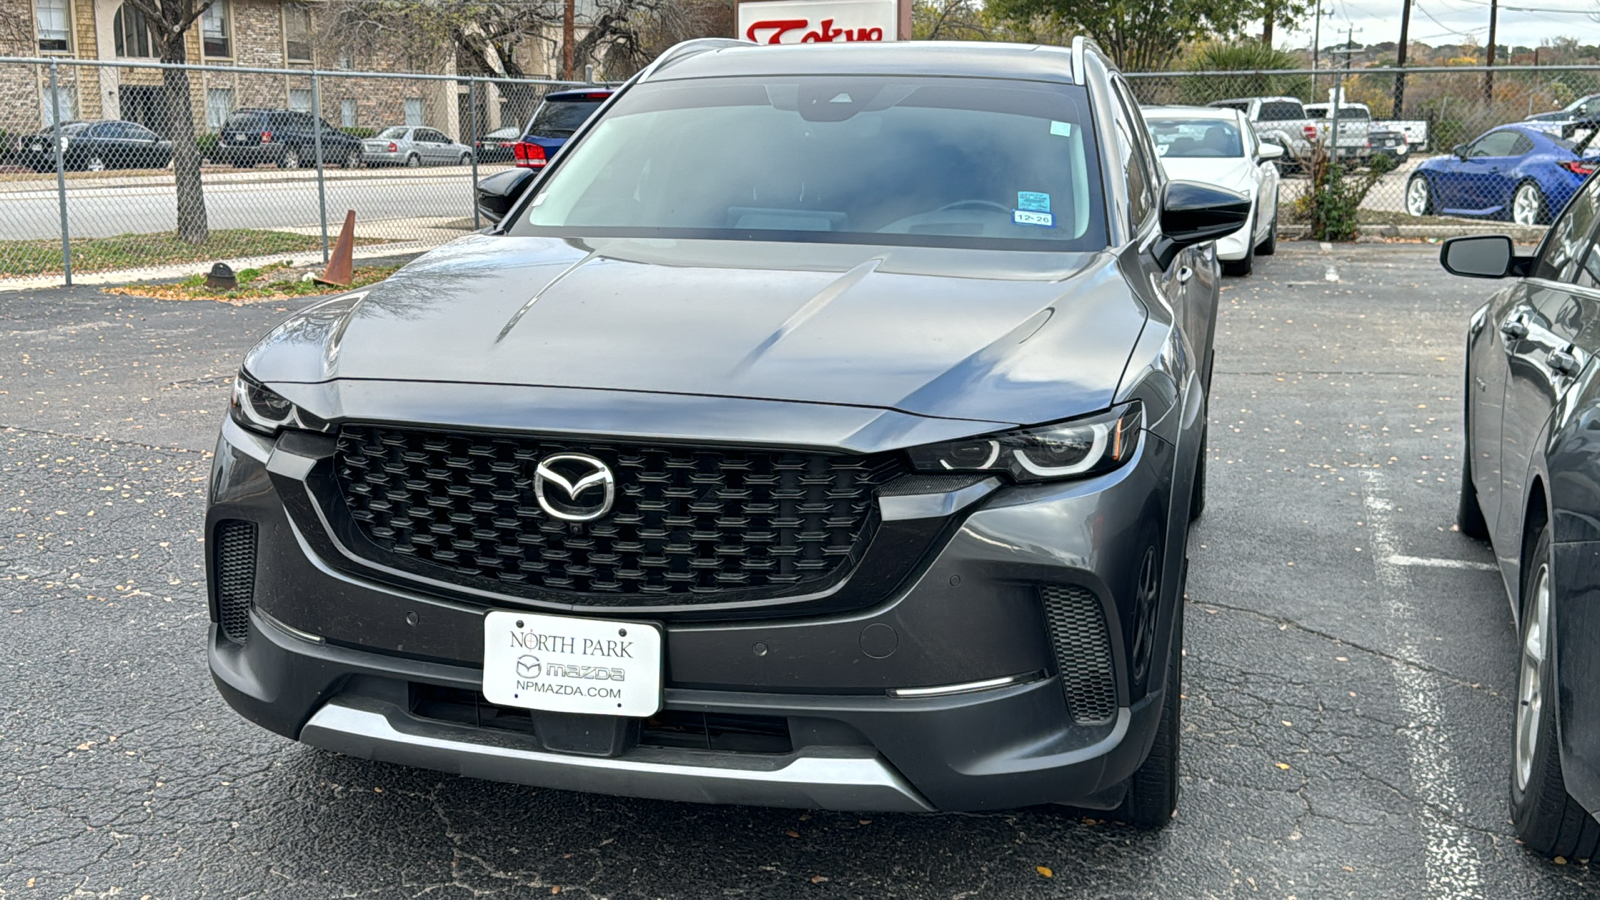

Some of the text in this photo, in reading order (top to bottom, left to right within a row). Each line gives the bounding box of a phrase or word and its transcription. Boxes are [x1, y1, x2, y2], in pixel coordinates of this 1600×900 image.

[510, 631, 634, 658] NORTH PARK
[516, 680, 622, 698] NPMAZDA.COM
